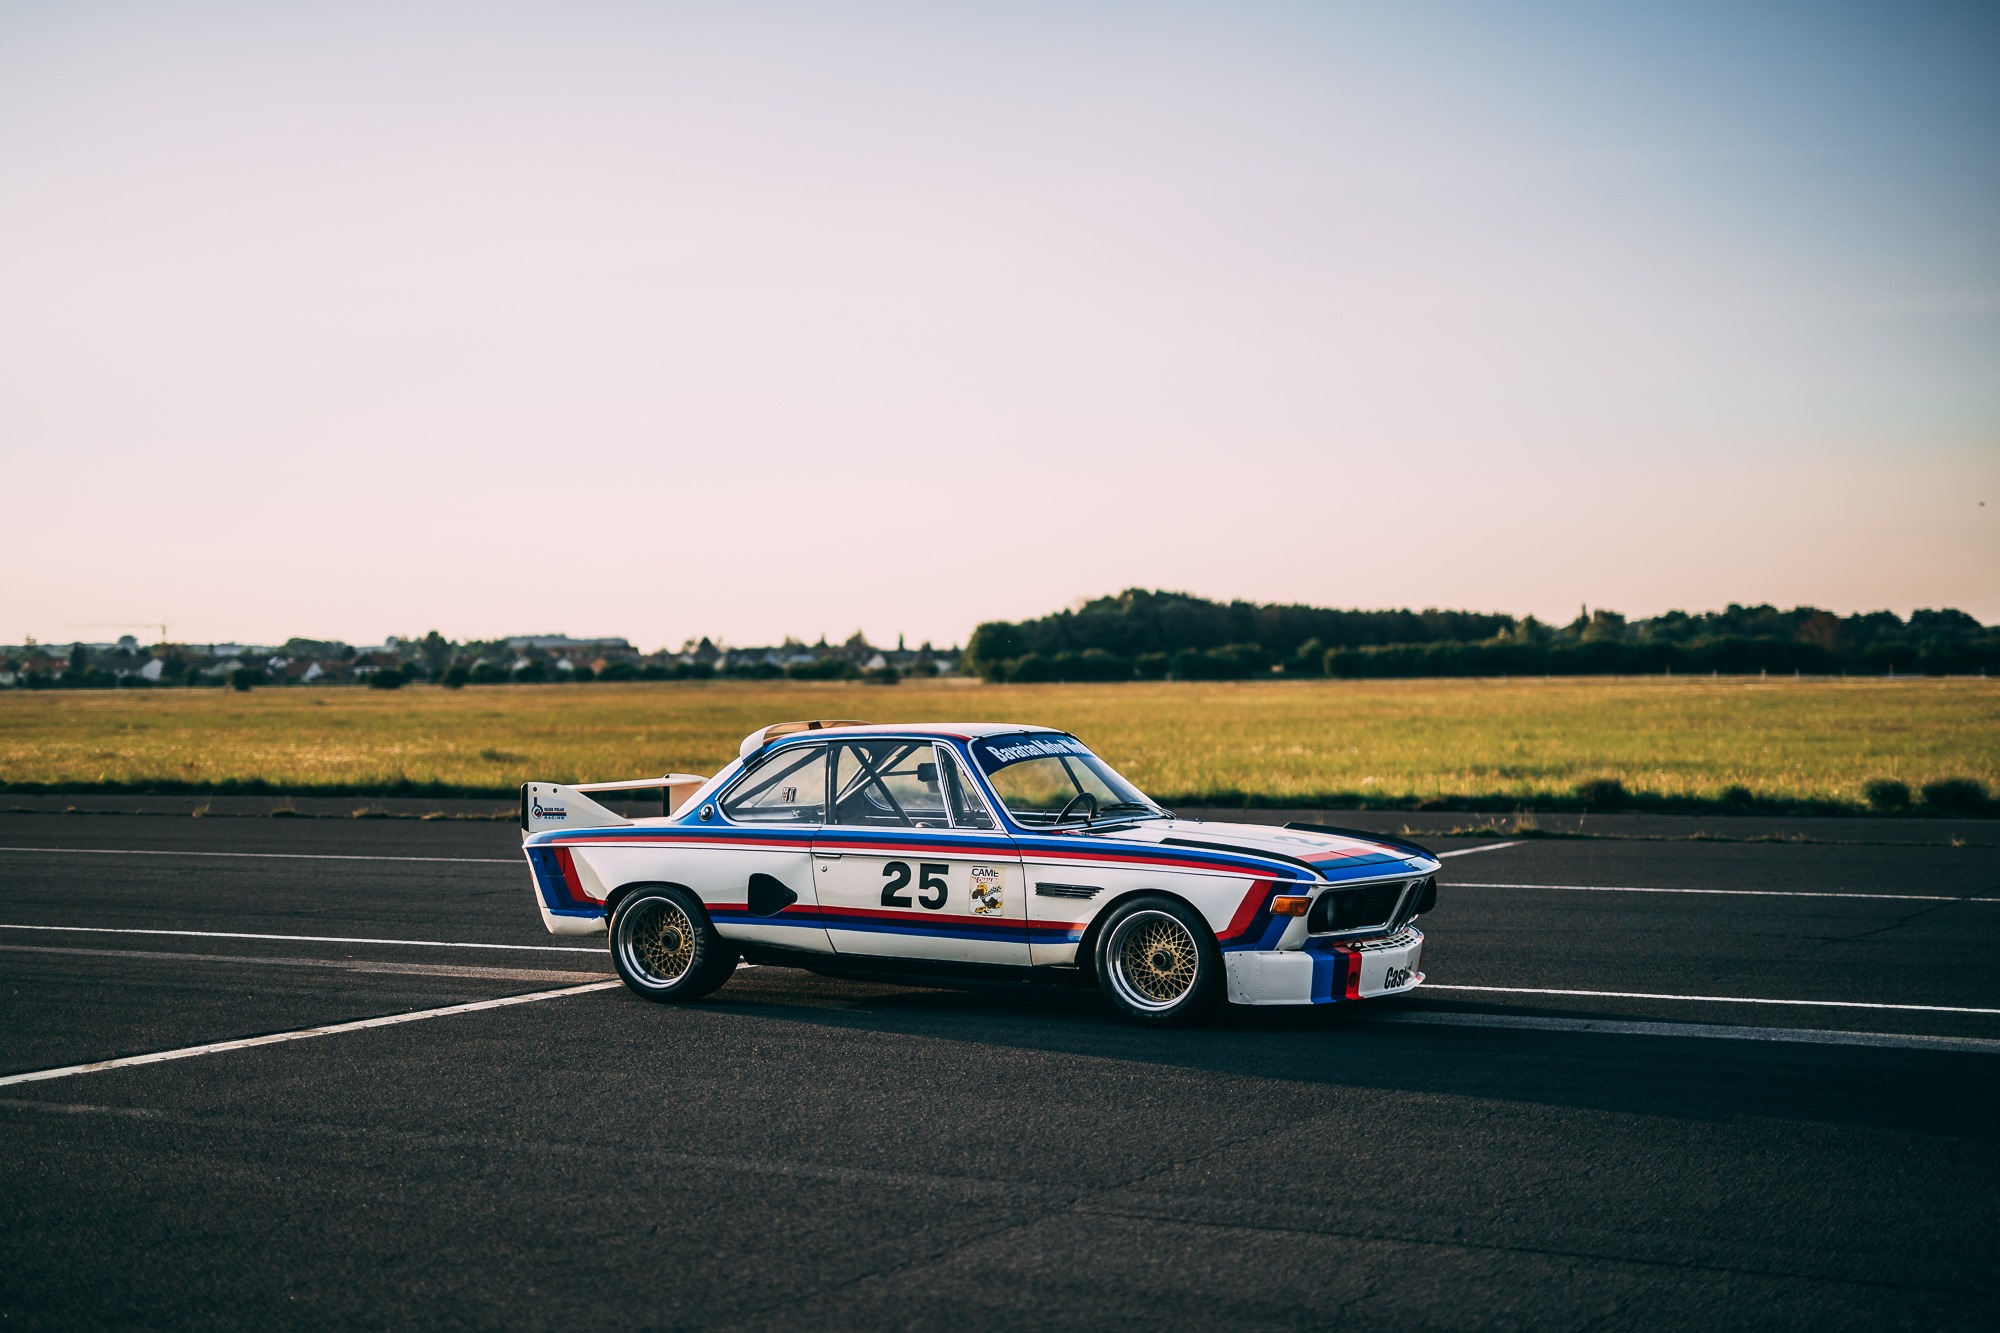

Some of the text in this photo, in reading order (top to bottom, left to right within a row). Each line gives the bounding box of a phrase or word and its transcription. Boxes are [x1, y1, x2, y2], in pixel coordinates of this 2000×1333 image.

[985, 742, 1040, 762] Bavarian
[1030, 739, 1071, 755] Motor
[881, 861, 949, 910] 25
